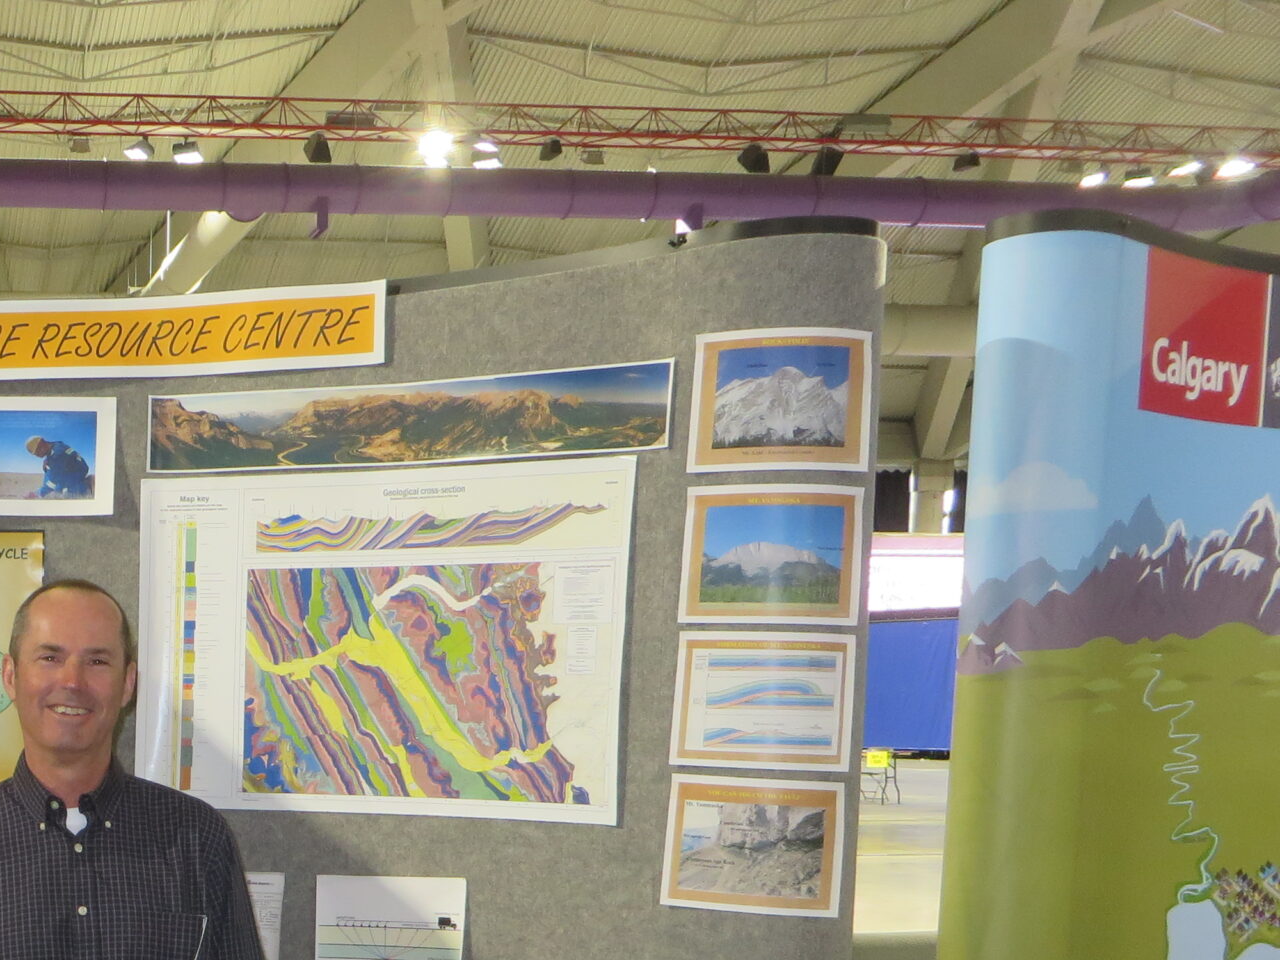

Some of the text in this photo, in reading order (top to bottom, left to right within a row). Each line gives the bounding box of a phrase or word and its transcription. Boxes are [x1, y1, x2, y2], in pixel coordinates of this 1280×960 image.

[31, 315, 220, 360] RESOURCE
[222, 305, 370, 354] CENTRE
[1151, 337, 1249, 408] Calgary
[179, 495, 210, 504] Map key
[382, 487, 419, 499] Geological
[420, 484, 466, 496] cross-section
